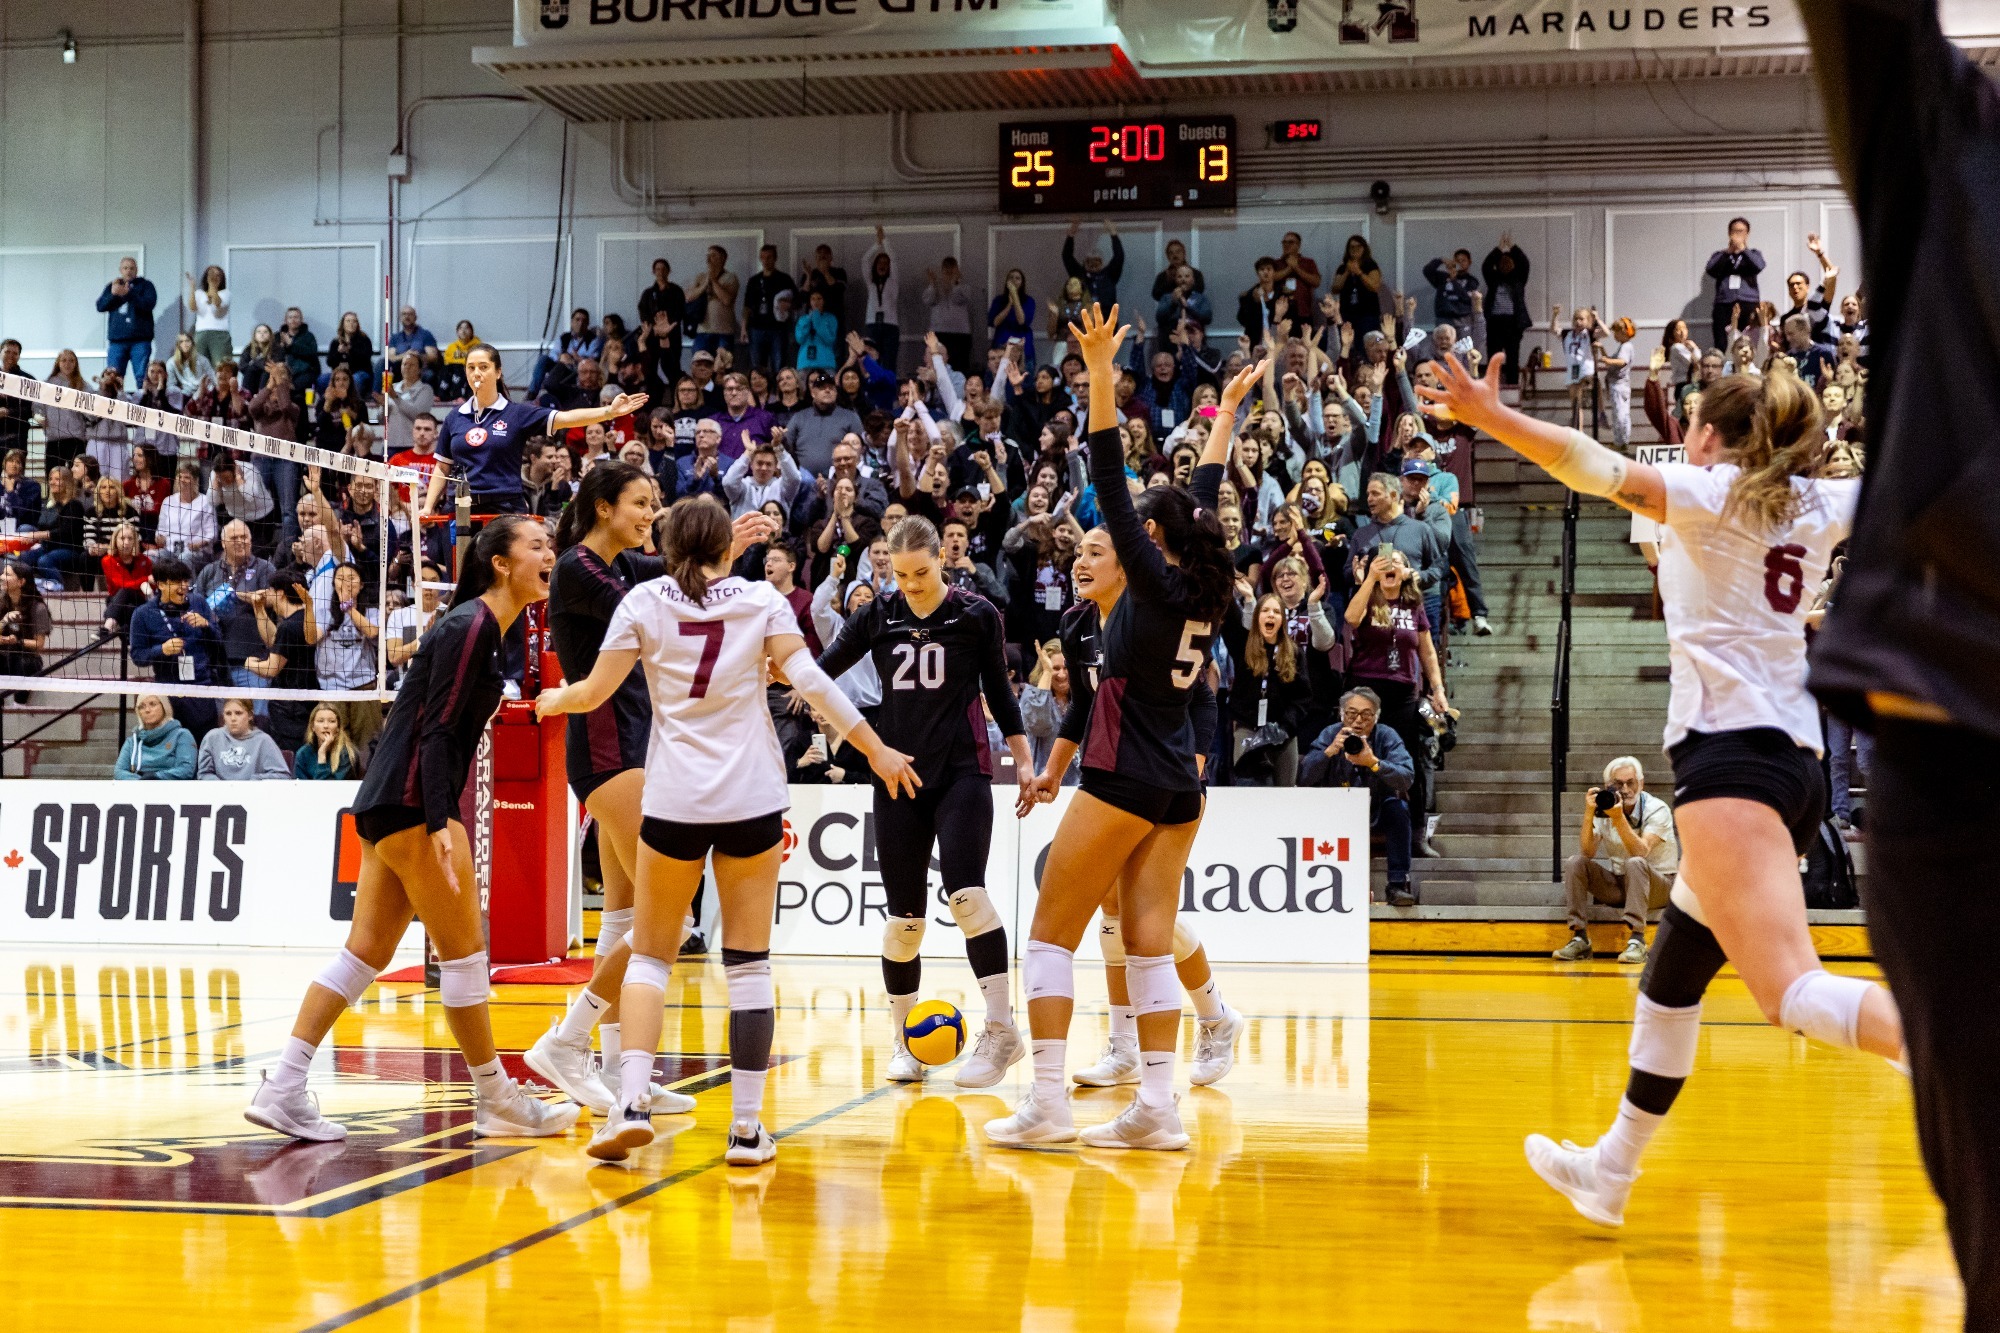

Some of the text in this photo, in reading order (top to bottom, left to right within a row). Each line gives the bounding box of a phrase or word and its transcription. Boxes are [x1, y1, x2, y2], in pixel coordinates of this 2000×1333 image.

[1468, 6, 1771, 37] MARAUDERS
[1011, 130, 1049, 146] Home
[1090, 124, 1165, 163] 2:00
[1179, 124, 1227, 141] Guests
[1287, 123, 1318, 138] 3:54
[1011, 150, 1055, 188] 25
[1199, 144, 1229, 182] 13
[1093, 185, 1138, 203] period
[1640, 447, 1685, 465] NEE
[1764, 543, 1807, 614] 6
[678, 619, 726, 699] 7
[892, 643, 945, 690] 20
[1171, 619, 1212, 689] 5
[500, 800, 535, 810] Senoh
[25, 803, 248, 922] SPORTS
